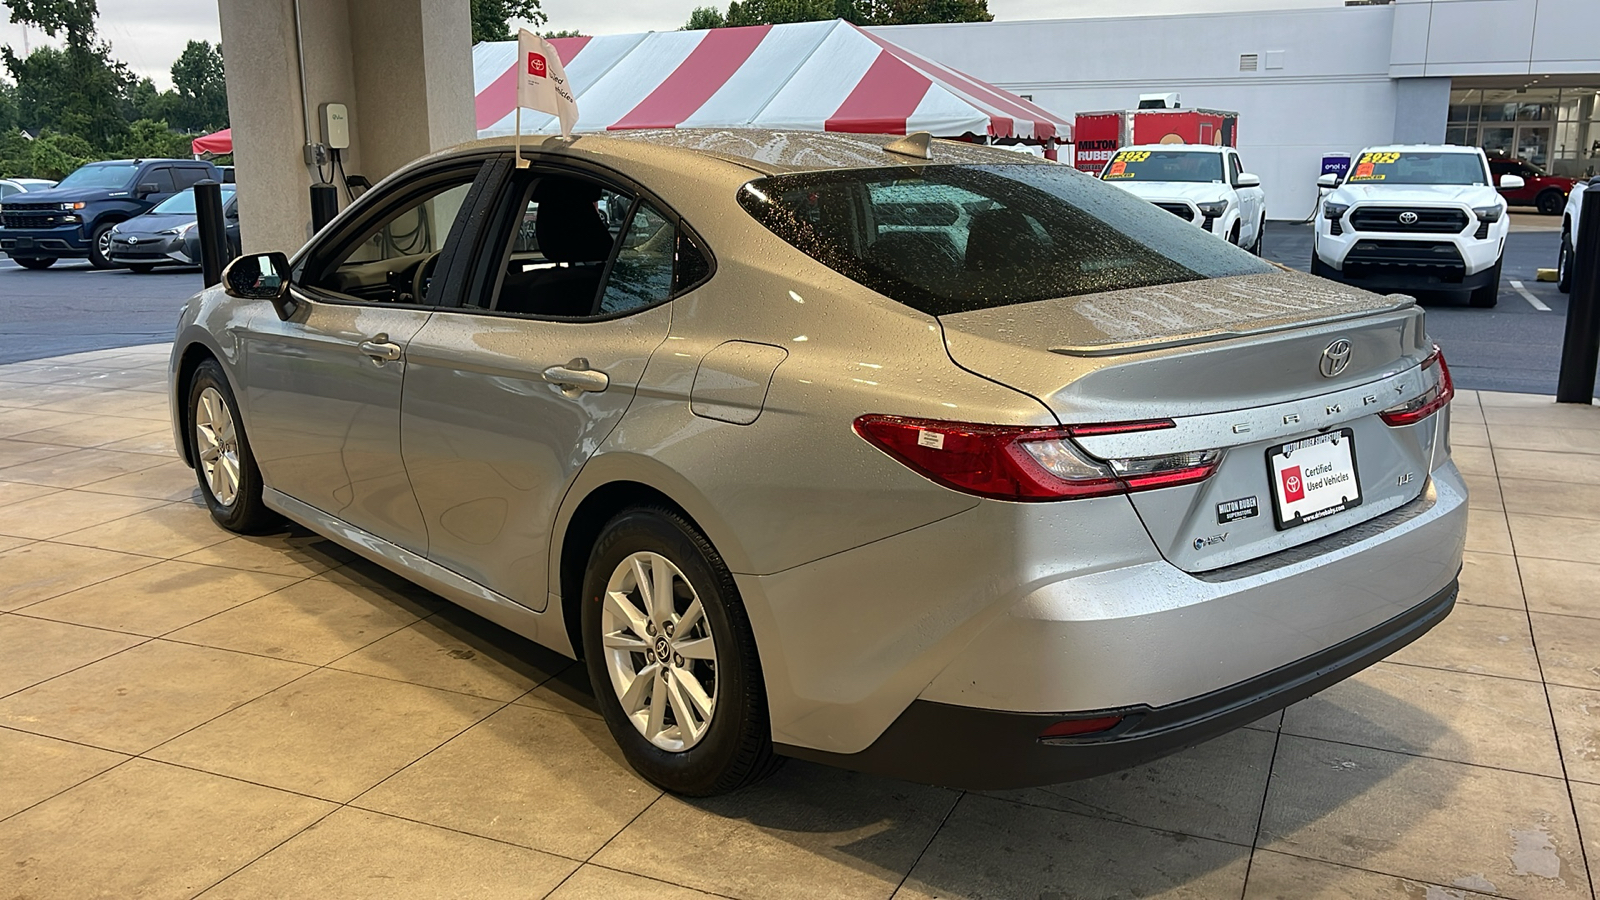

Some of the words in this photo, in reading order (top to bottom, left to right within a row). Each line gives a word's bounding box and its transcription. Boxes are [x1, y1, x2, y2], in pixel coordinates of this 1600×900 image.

[1078, 140, 1116, 150] MILTON
[1232, 384, 1405, 434] CAMRY
[1282, 441, 1300, 453] MILTON
[1301, 437, 1316, 448] RUBEN
[1316, 430, 1342, 445] SUPERSTORE
[1305, 462, 1333, 478] Certified
[1307, 480, 1324, 492] Used
[1323, 472, 1350, 487] Vehicles
[1218, 501, 1239, 514] MILTON
[1239, 497, 1257, 509] RUBEN
[1226, 508, 1252, 519] SUPERSTORE
